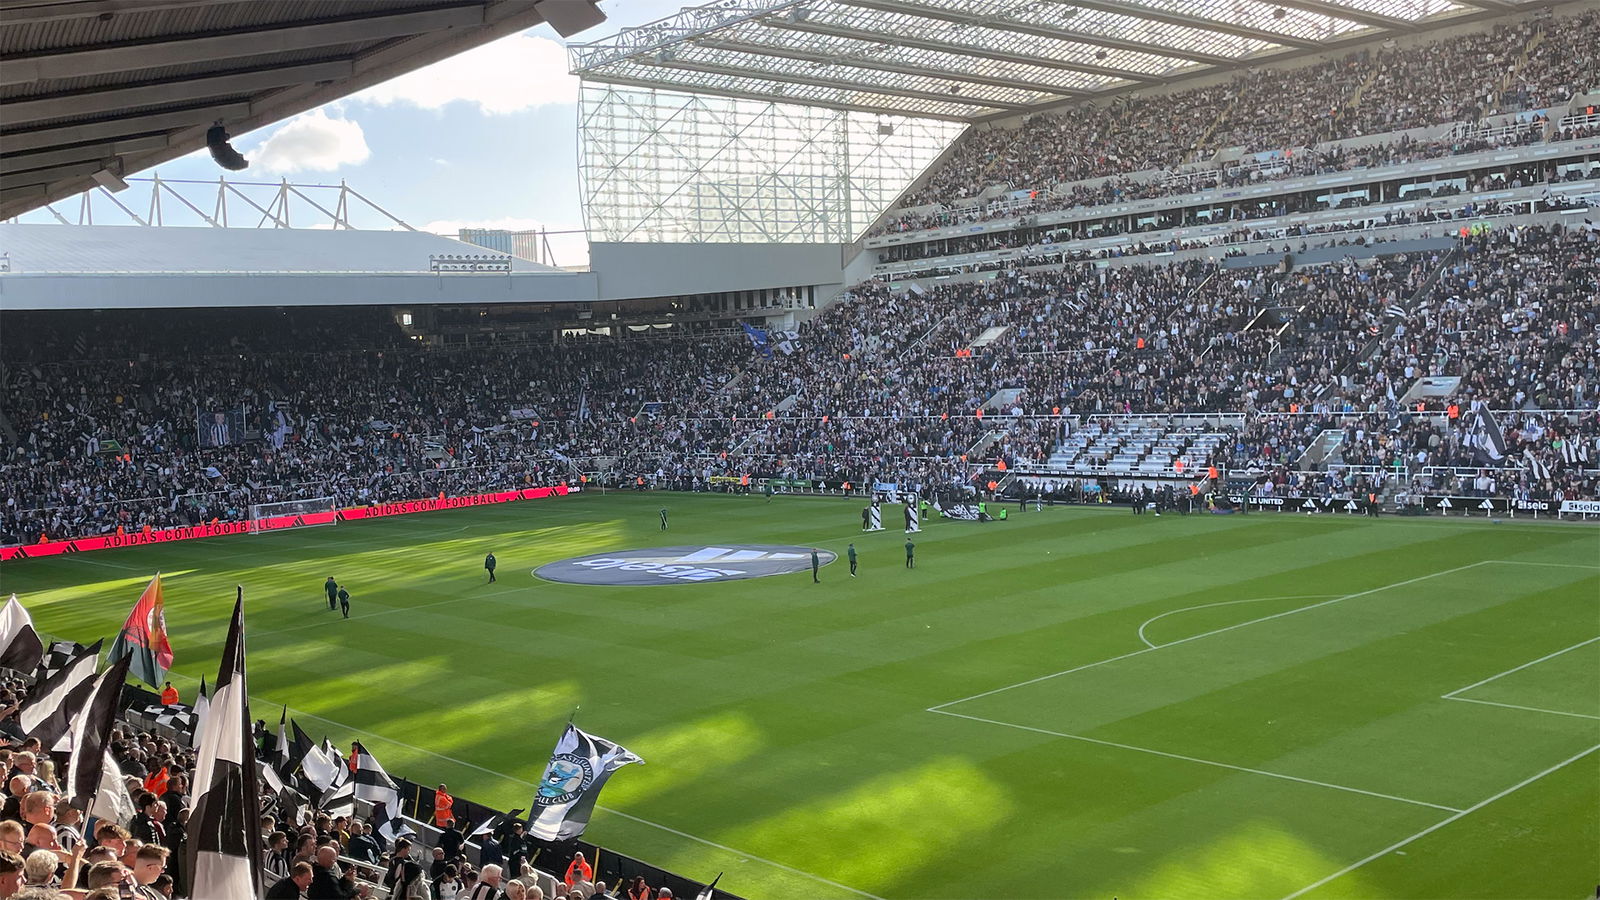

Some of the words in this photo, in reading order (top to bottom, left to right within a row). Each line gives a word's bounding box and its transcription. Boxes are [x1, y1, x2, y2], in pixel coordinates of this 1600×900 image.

[365, 493, 498, 518] ADIDAS.COM/FOOTBALL
[104, 518, 272, 548] ADIDAS.COM/FOOTBALL
[552, 793, 575, 804] CLUB
